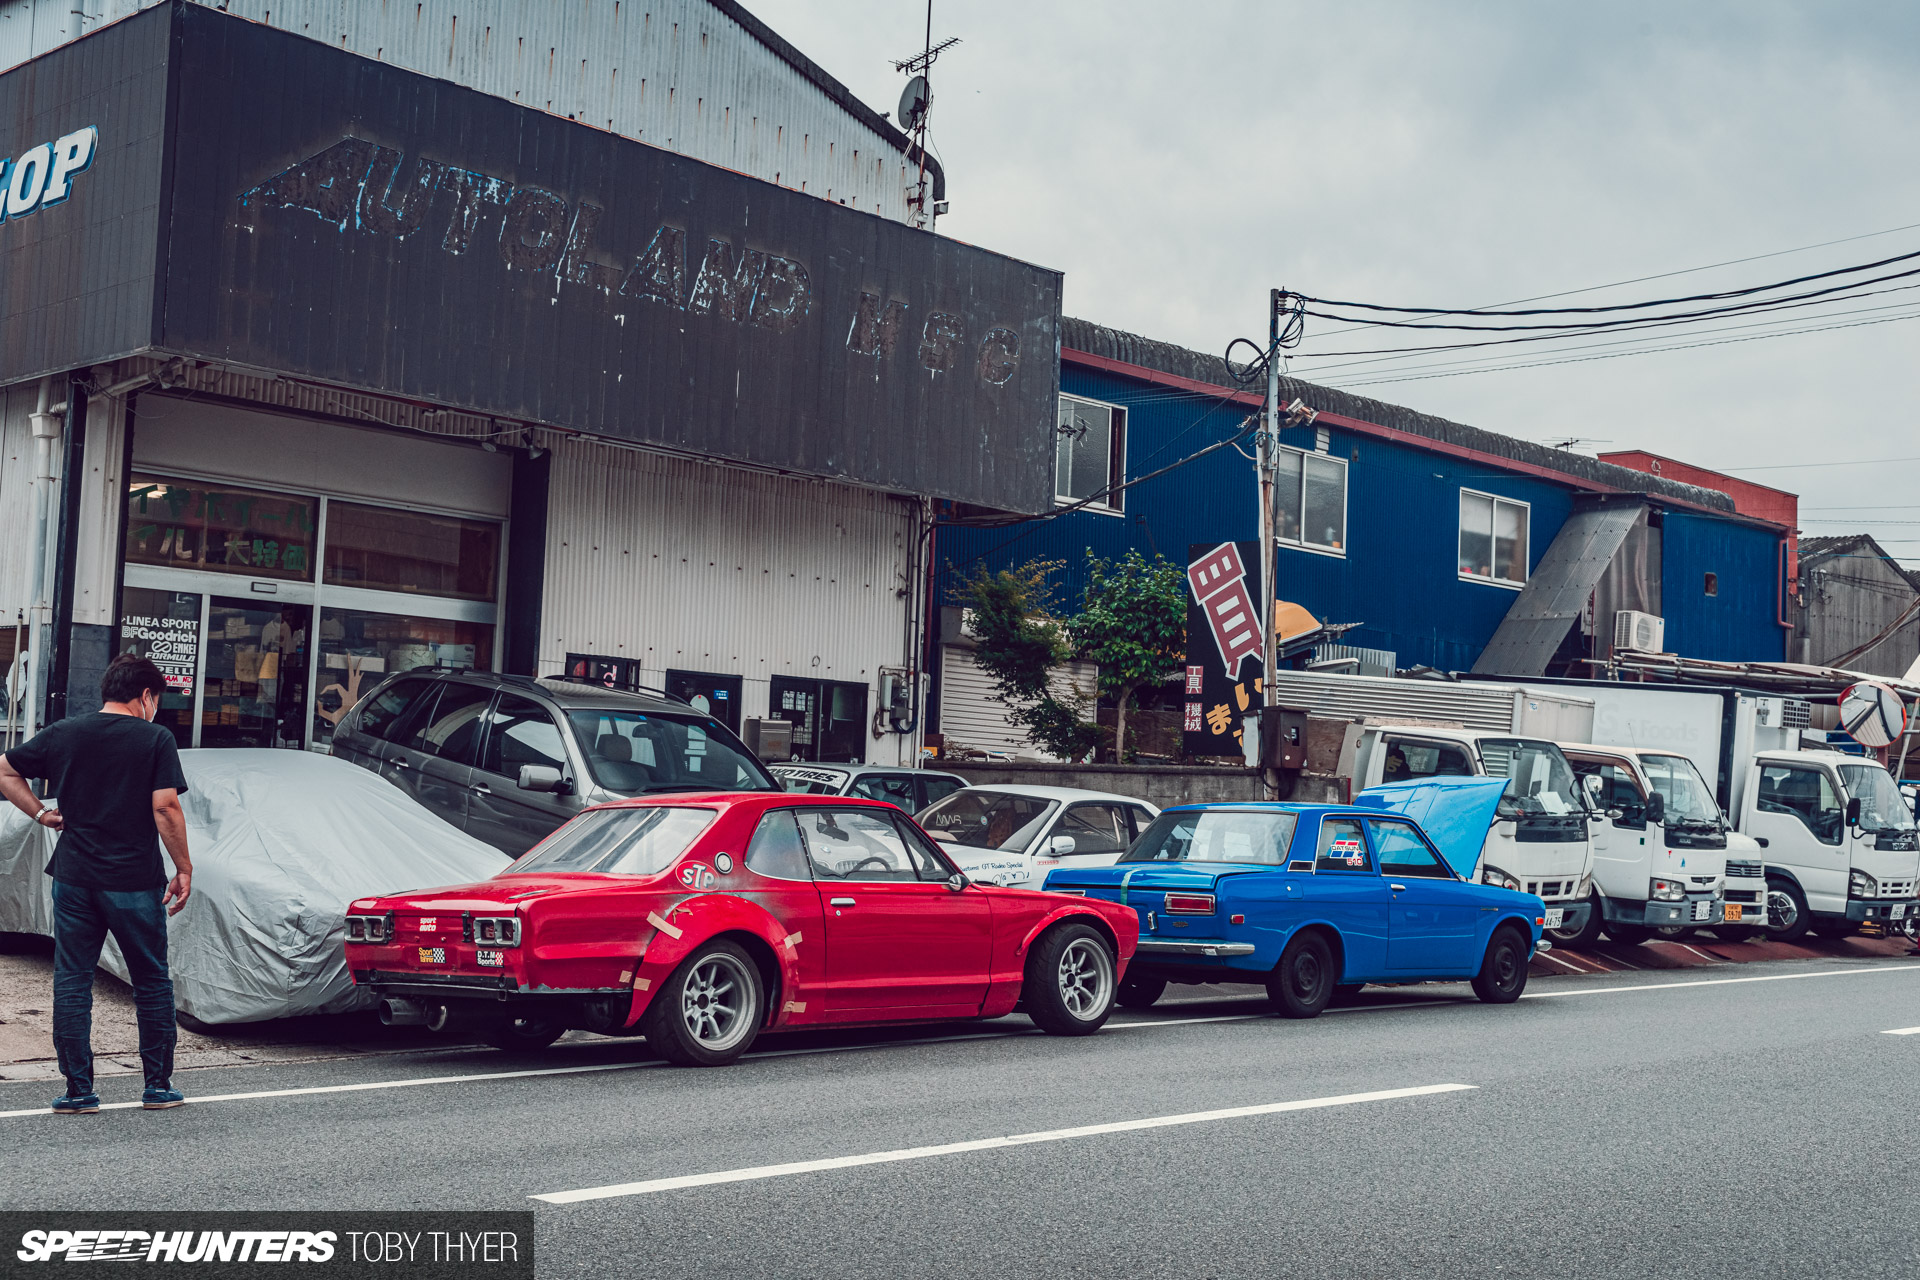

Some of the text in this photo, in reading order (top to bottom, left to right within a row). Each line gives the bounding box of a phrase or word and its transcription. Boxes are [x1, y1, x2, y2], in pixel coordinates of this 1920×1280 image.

[0, 126, 98, 222] OP
[126, 615, 198, 630] LINEA SPORT
[121, 625, 197, 643] BFGoodrich
[172, 642, 196, 655] ENKEI
[145, 651, 195, 662] FORMULA
[1187, 665, 1202, 694] 工具
[1184, 702, 1202, 731] 機械
[793, 770, 838, 782] TIRES
[1346, 858, 1363, 866] 510
[681, 863, 716, 889] STP
[419, 924, 437, 932] auto
[477, 950, 496, 958] D.T.M
[477, 957, 496, 966] Sports
